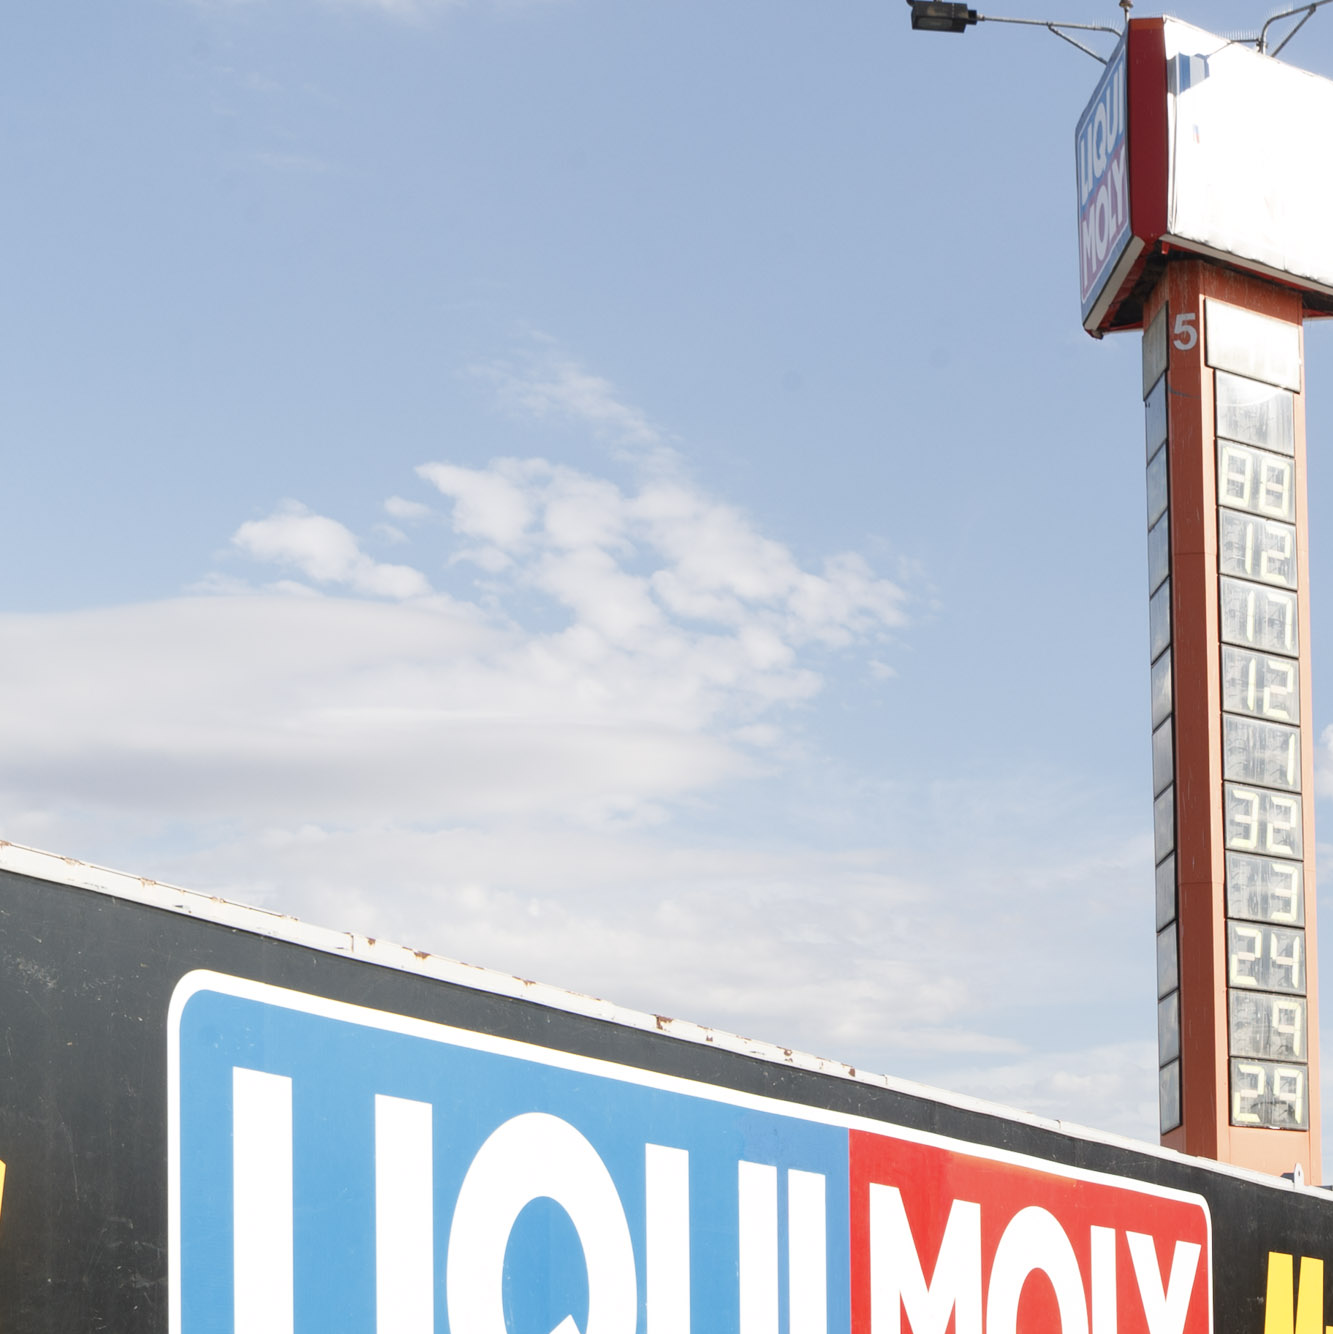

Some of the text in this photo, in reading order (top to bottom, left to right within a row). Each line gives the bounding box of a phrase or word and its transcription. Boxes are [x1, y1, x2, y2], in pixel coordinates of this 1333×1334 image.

[1080, 60, 1123, 198] LIQUI
[1082, 155, 1127, 287] MOLY
[1173, 312, 1197, 350] 5
[1222, 446, 1290, 516] 88
[1244, 521, 1291, 583] 12
[1246, 589, 1293, 650] 17
[1248, 657, 1293, 719] 12
[1286, 732, 1296, 787] 1
[1230, 788, 1297, 855] 32
[1271, 862, 1298, 922] 3
[1231, 926, 1300, 990] 24
[1272, 1000, 1301, 1057] 9
[1234, 1063, 1303, 1124] 29
